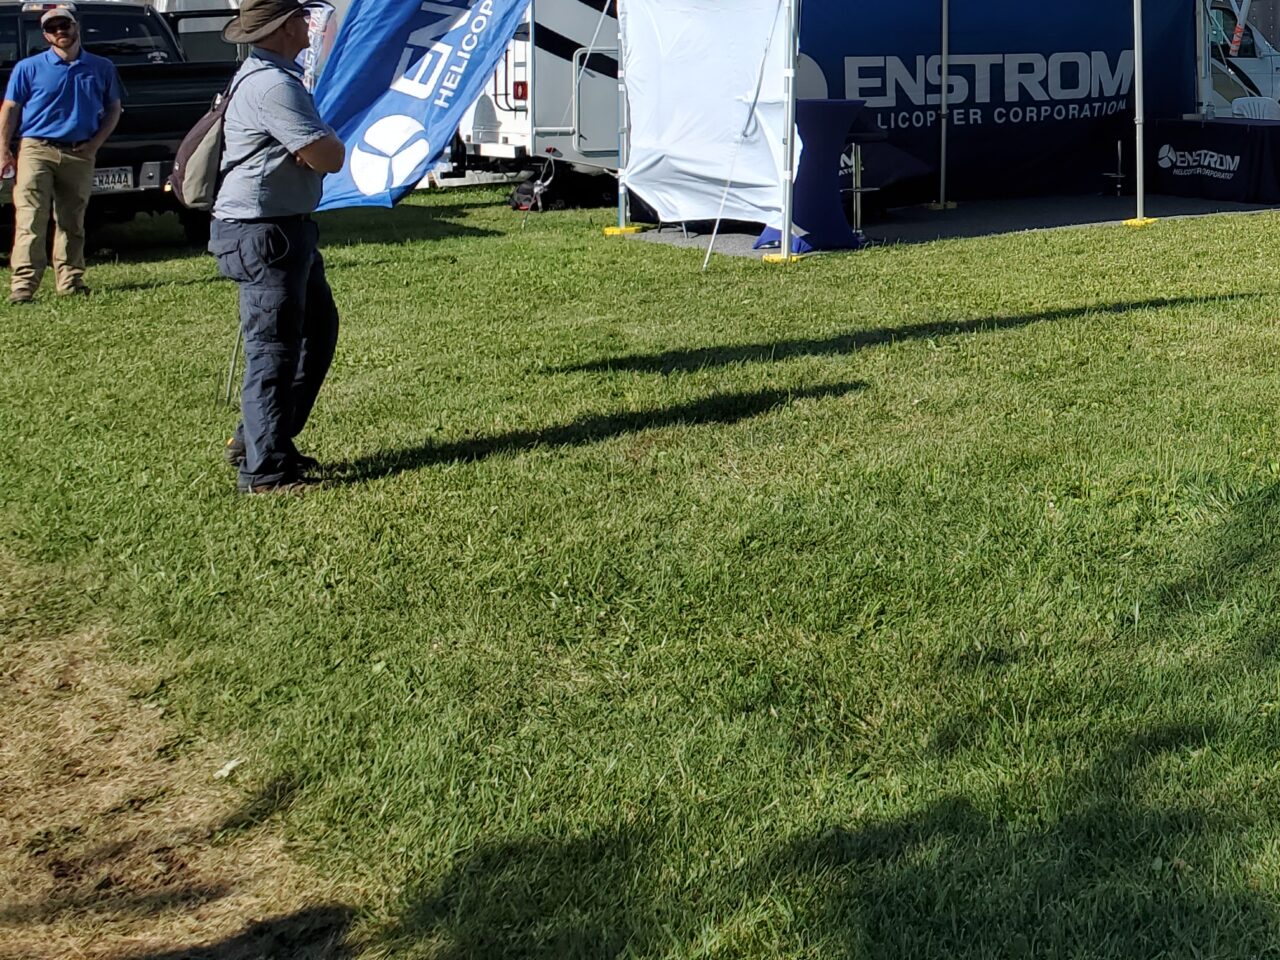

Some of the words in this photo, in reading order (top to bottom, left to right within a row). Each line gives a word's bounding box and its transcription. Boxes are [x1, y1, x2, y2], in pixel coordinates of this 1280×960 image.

[844, 49, 1135, 107] ENSTROM
[877, 109, 983, 129] LICOPER
[994, 98, 1127, 124] CORPORATION
[1175, 149, 1241, 171] ENSTROM
